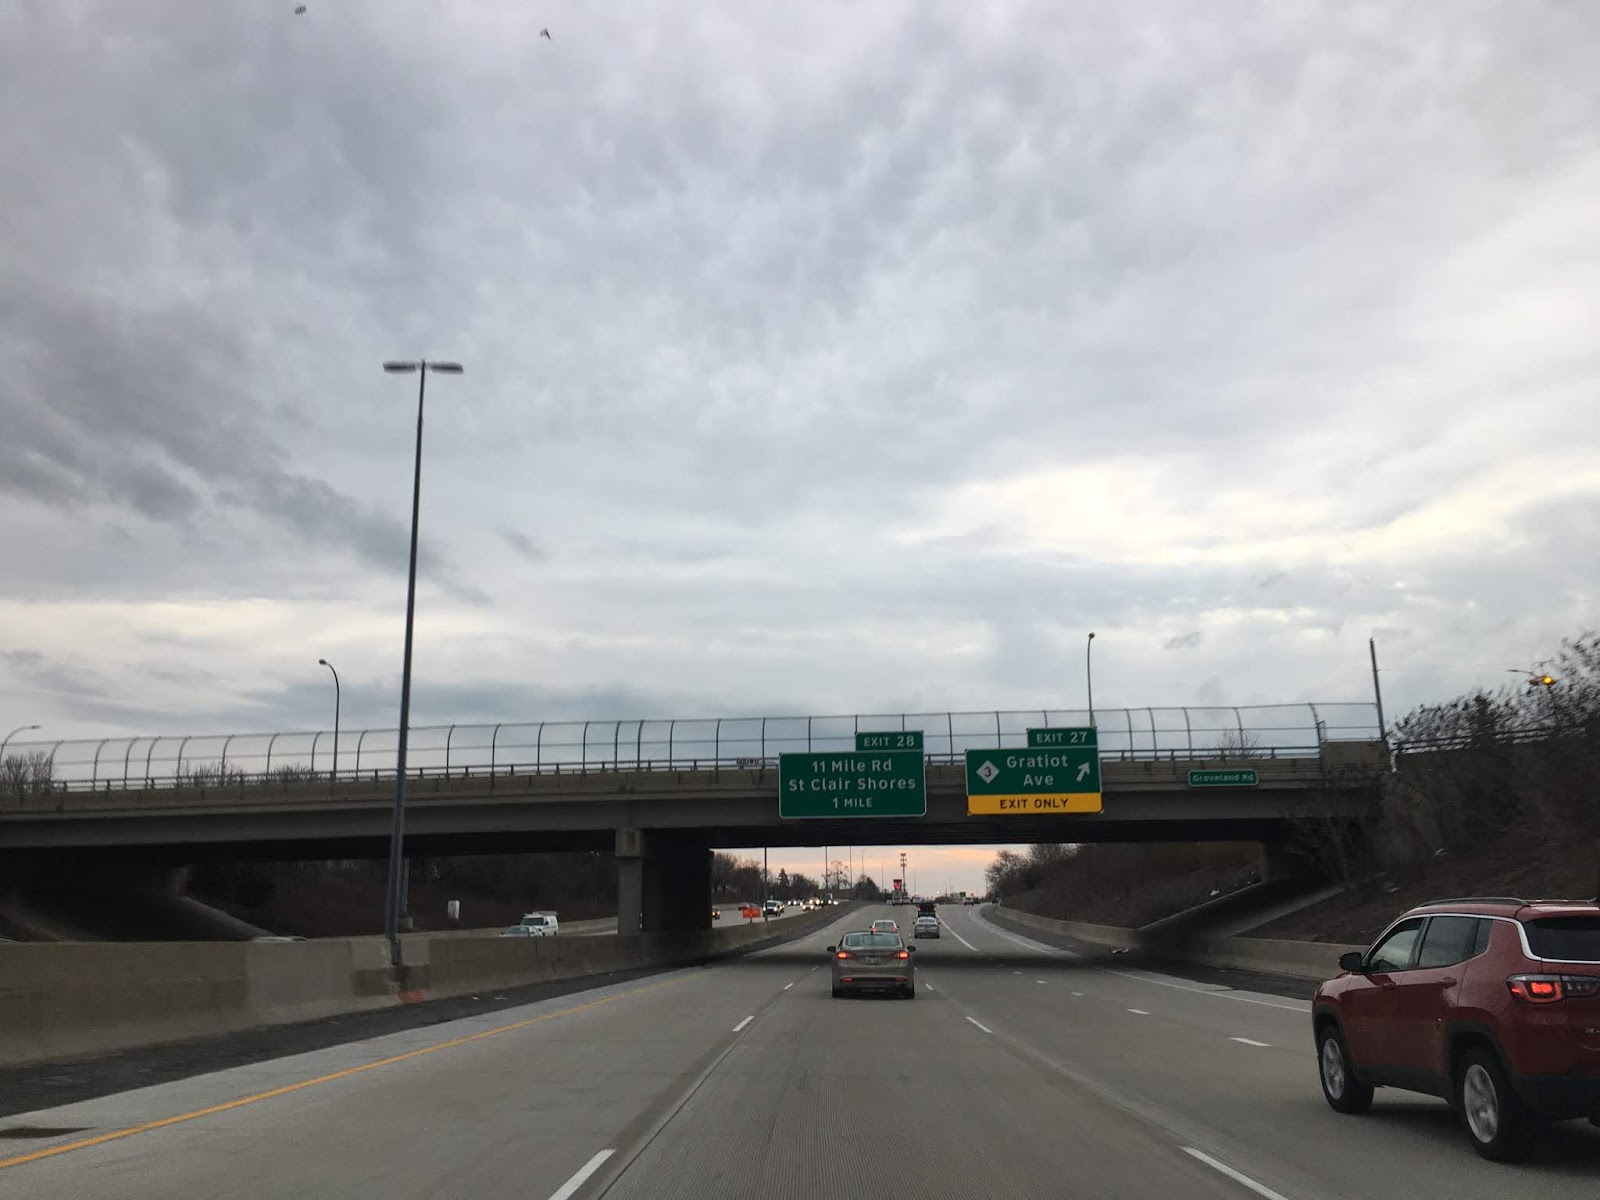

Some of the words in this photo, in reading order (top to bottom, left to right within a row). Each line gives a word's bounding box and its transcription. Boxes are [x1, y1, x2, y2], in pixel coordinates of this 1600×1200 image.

[863, 736, 890, 747] EXIT
[897, 735, 915, 747] 28
[1036, 733, 1063, 743] EXIT
[1070, 731, 1088, 743] 27
[812, 761, 826, 773] 11
[831, 759, 866, 773] Mile
[872, 758, 892, 772] Rd
[1006, 755, 1069, 768] Gratiot
[983, 766, 992, 778] 3
[789, 779, 804, 791] St
[811, 777, 850, 792] Clair
[857, 777, 916, 790] Shores
[1023, 774, 1054, 787] Ave
[832, 797, 839, 809] 1
[844, 798, 873, 808] MILE
[999, 799, 1028, 809] EXIT
[1034, 798, 1069, 809] ONLY
